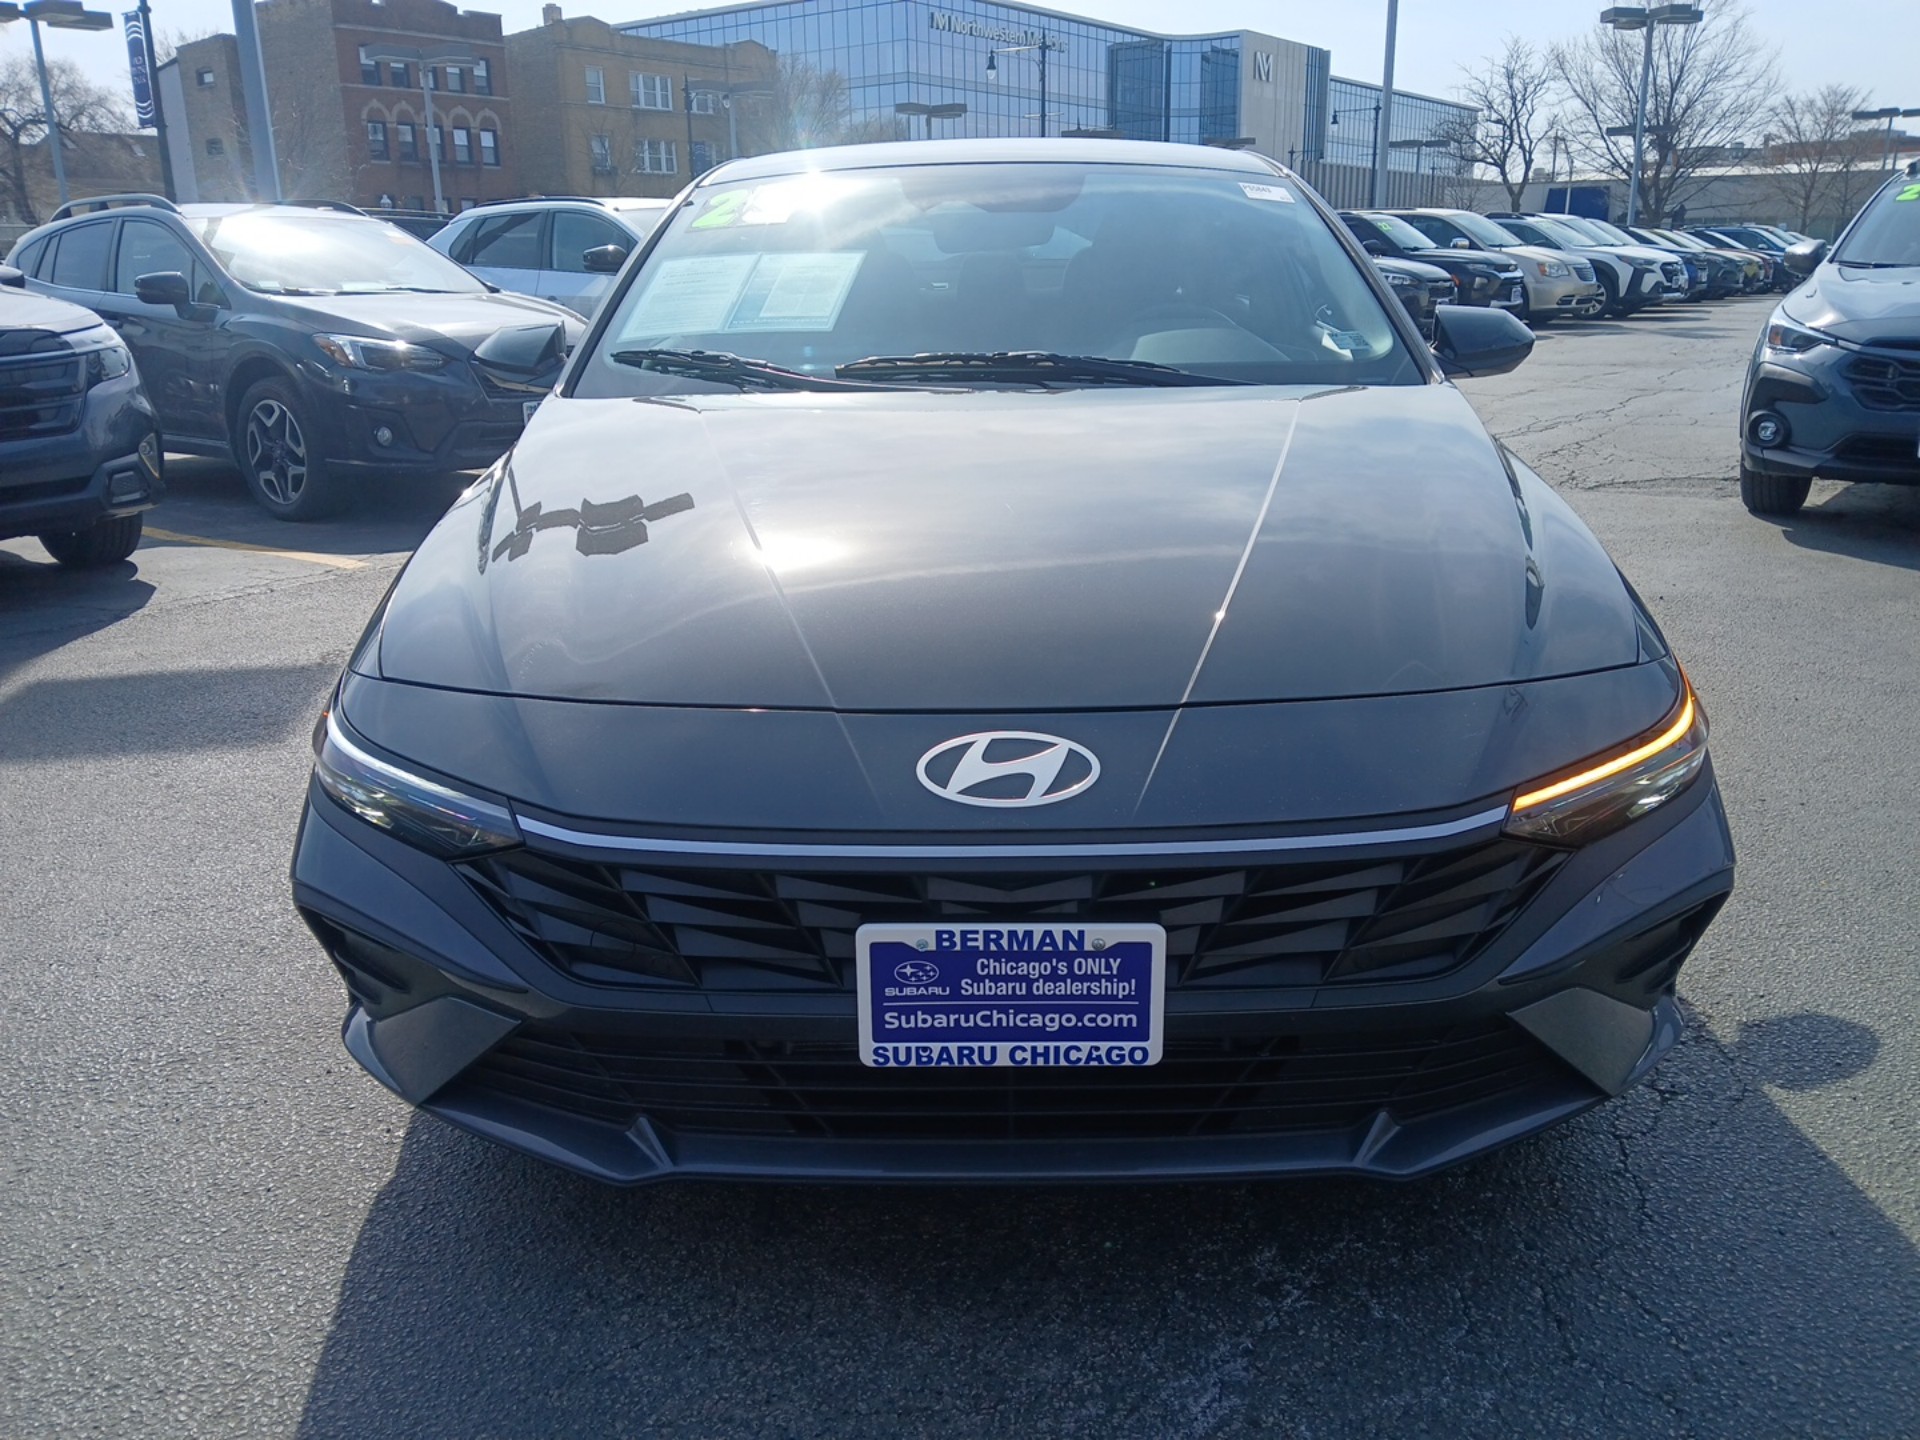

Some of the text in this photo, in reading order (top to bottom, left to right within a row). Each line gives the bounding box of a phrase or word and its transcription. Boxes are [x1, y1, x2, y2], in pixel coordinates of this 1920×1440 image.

[952, 13, 1026, 45] Northwestern
[935, 930, 1085, 950] BERMAN
[976, 958, 1121, 979] Chicago's ONLY
[884, 986, 949, 996] SUBARU
[960, 979, 1136, 998] Subaru dealership!
[884, 1010, 1137, 1031] SubaruChicago.com
[872, 1045, 1149, 1066] SUBARU CHICAGO
